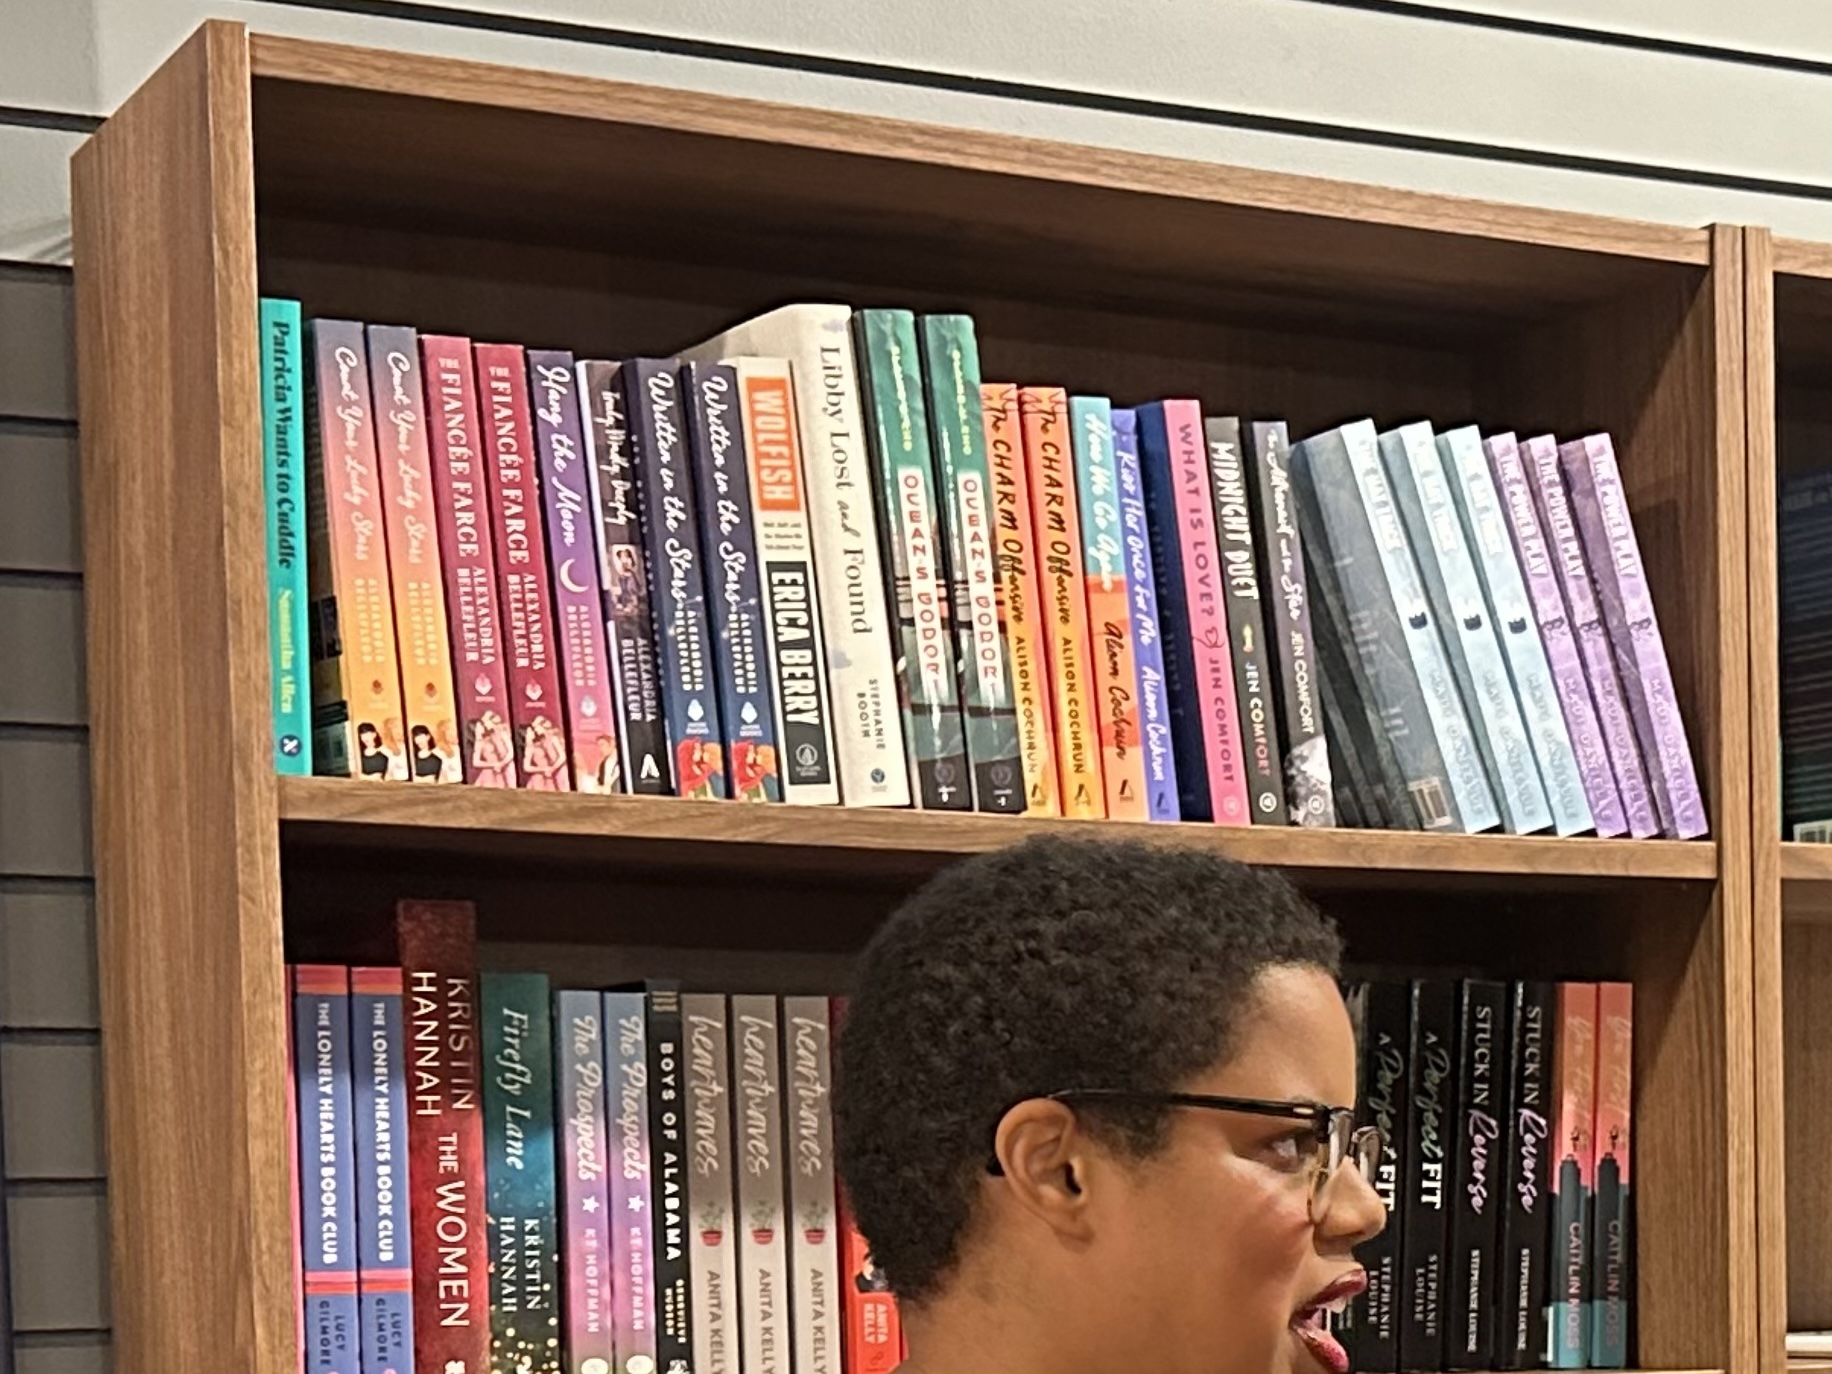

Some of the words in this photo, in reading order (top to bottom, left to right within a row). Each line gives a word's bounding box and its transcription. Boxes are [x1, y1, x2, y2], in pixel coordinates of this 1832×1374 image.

[272, 321, 292, 402] Patricia
[820, 346, 847, 424] Libby
[441, 373, 474, 475] FIANCÉE
[537, 365, 571, 427] Hang
[648, 372, 678, 464] Written
[702, 376, 732, 468] Written
[276, 408, 292, 473] Wants
[491, 381, 524, 483] FIANCÉE
[551, 433, 577, 472] the
[752, 389, 796, 500] WOLFISH
[830, 431, 855, 491] Lost
[1179, 423, 1199, 498] WHAT
[276, 474, 292, 494] to
[552, 477, 582, 547] Moon
[659, 468, 675, 491] in
[714, 472, 729, 495] in
[991, 439, 1019, 531] CHARM
[1041, 441, 1067, 533] CHARM
[1209, 441, 1251, 545] MIDNIGHT
[277, 498, 295, 569] Cuddle
[452, 481, 480, 557] FARGE
[502, 489, 530, 564] FARGE
[664, 496, 687, 533] the
[717, 500, 741, 536] the
[837, 499, 861, 538] and
[1190, 508, 1204, 530] IS
[665, 538, 693, 599] Stars
[719, 541, 747, 602] Stars
[843, 548, 872, 634] Found
[1000, 538, 1027, 624] Offensive
[1046, 540, 1074, 626] Offensive
[1121, 497, 1142, 534] Her
[1135, 612, 1157, 646] Me
[1193, 541, 1215, 617] LOVE?
[1224, 550, 1259, 600] DUET
[1523, 540, 1549, 576] PLAY
[1561, 541, 1587, 577] PLAY
[1613, 539, 1639, 577] PLAY
[771, 571, 810, 642] ERICA
[780, 649, 820, 724] BERRY
[1015, 636, 1031, 692] ALISON
[1062, 637, 1079, 693] ALISON
[1208, 657, 1223, 689] JEN
[1245, 661, 1260, 693] JEN
[1294, 659, 1314, 733] COMFORT
[868, 678, 886, 750] STEPHANIE
[1068, 698, 1086, 774] COCHRUN
[1214, 696, 1234, 783] COMFORT
[1250, 697, 1271, 777] COMFORT
[317, 1030, 333, 1094] LONELY
[372, 1030, 389, 1094] LONELY
[411, 971, 442, 1118] HANNAH
[446, 978, 474, 1112] KRISTIN
[496, 1007, 532, 1102] Firefly
[573, 1015, 597, 1057] The
[618, 1016, 643, 1057] The
[1473, 1005, 1492, 1076] STUCK
[1523, 1005, 1542, 1076] STUCK
[660, 1042, 676, 1101] BOYS
[1415, 1049, 1450, 1159] Perfect
[1473, 1079, 1489, 1106] IN
[1524, 1079, 1539, 1106] IN
[319, 1098, 336, 1163] HEARTS
[374, 1097, 391, 1163] HEARTS
[436, 1132, 459, 1175] THE
[504, 1105, 532, 1171] Lane
[570, 1061, 602, 1181] Prospects
[615, 1061, 648, 1180] Prospects
[662, 1112, 678, 1140] OF
[320, 1166, 337, 1218] BOOK
[376, 1165, 393, 1216] BOOK
[1420, 1162, 1442, 1210] FIT
[1468, 1108, 1499, 1215] Reverse
[1518, 1108, 1548, 1214] Reverse
[585, 1228, 598, 1248] KT
[630, 1227, 643, 1246] KT
[663, 1152, 683, 1261] ALABAMA
[322, 1221, 338, 1264] CLUB
[378, 1218, 394, 1262] CLUB
[435, 1181, 470, 1328] WOMEN
[500, 1216, 517, 1314] HANNAH
[524, 1217, 550, 1312] KRISTIN
[1568, 1222, 1584, 1294] CAITLIN
[585, 1254, 600, 1333] HOFFMAN
[630, 1252, 644, 1331] HOFFMAN
[707, 1270, 725, 1325] ANITA
[759, 1268, 777, 1323] ANITA
[811, 1268, 829, 1323] ANITA
[863, 1302, 876, 1345] KELLY
[875, 1302, 888, 1345] ANITA
